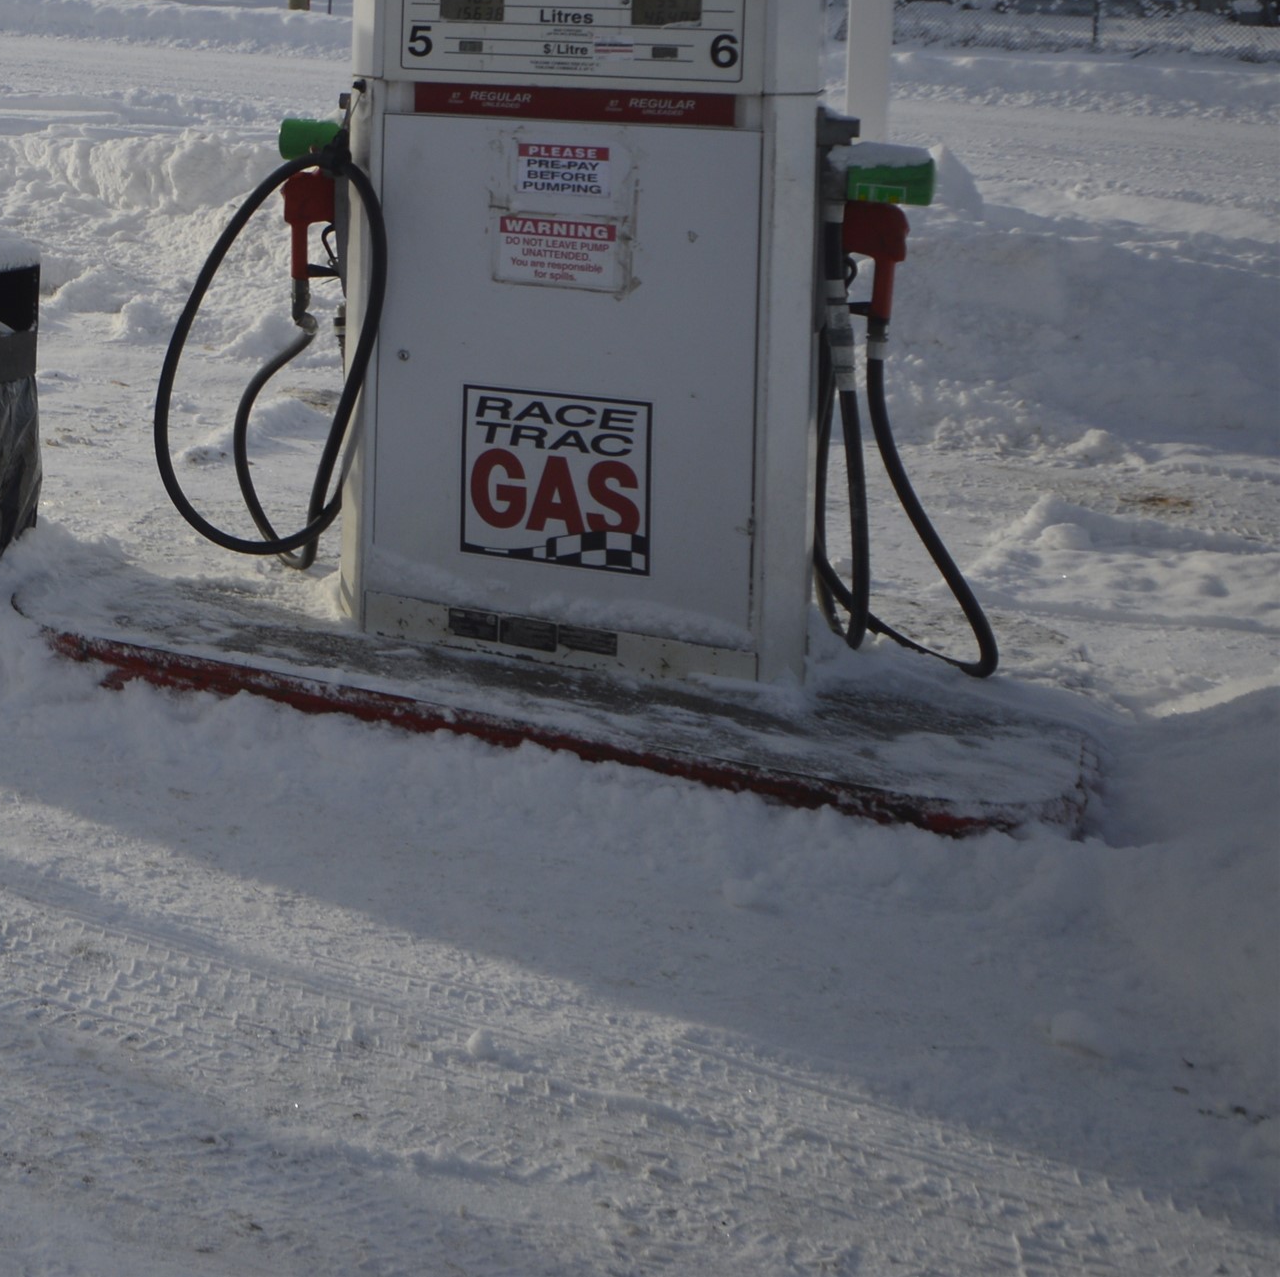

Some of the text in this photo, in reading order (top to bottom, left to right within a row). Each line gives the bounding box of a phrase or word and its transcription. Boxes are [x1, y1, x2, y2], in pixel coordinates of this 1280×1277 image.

[540, 9, 594, 25] Litres
[407, 25, 432, 58] 5
[543, 43, 588, 55] $/Litre
[710, 34, 738, 68] 6
[469, 90, 532, 103] REGULAR
[628, 97, 696, 110] REGULAR
[528, 145, 598, 159] PLEASE
[526, 158, 600, 171] PRE-PAY
[527, 169, 599, 183] BEFORE
[522, 180, 602, 195] PUMPING
[505, 218, 609, 239] WARNING
[505, 236, 610, 252] DO NOT LEAVE PUMP
[511, 257, 604, 274] You are responsible
[534, 269, 547, 278] for
[475, 395, 639, 432] RACE
[475, 421, 635, 458] TRAC
[470, 447, 641, 535] GAS
